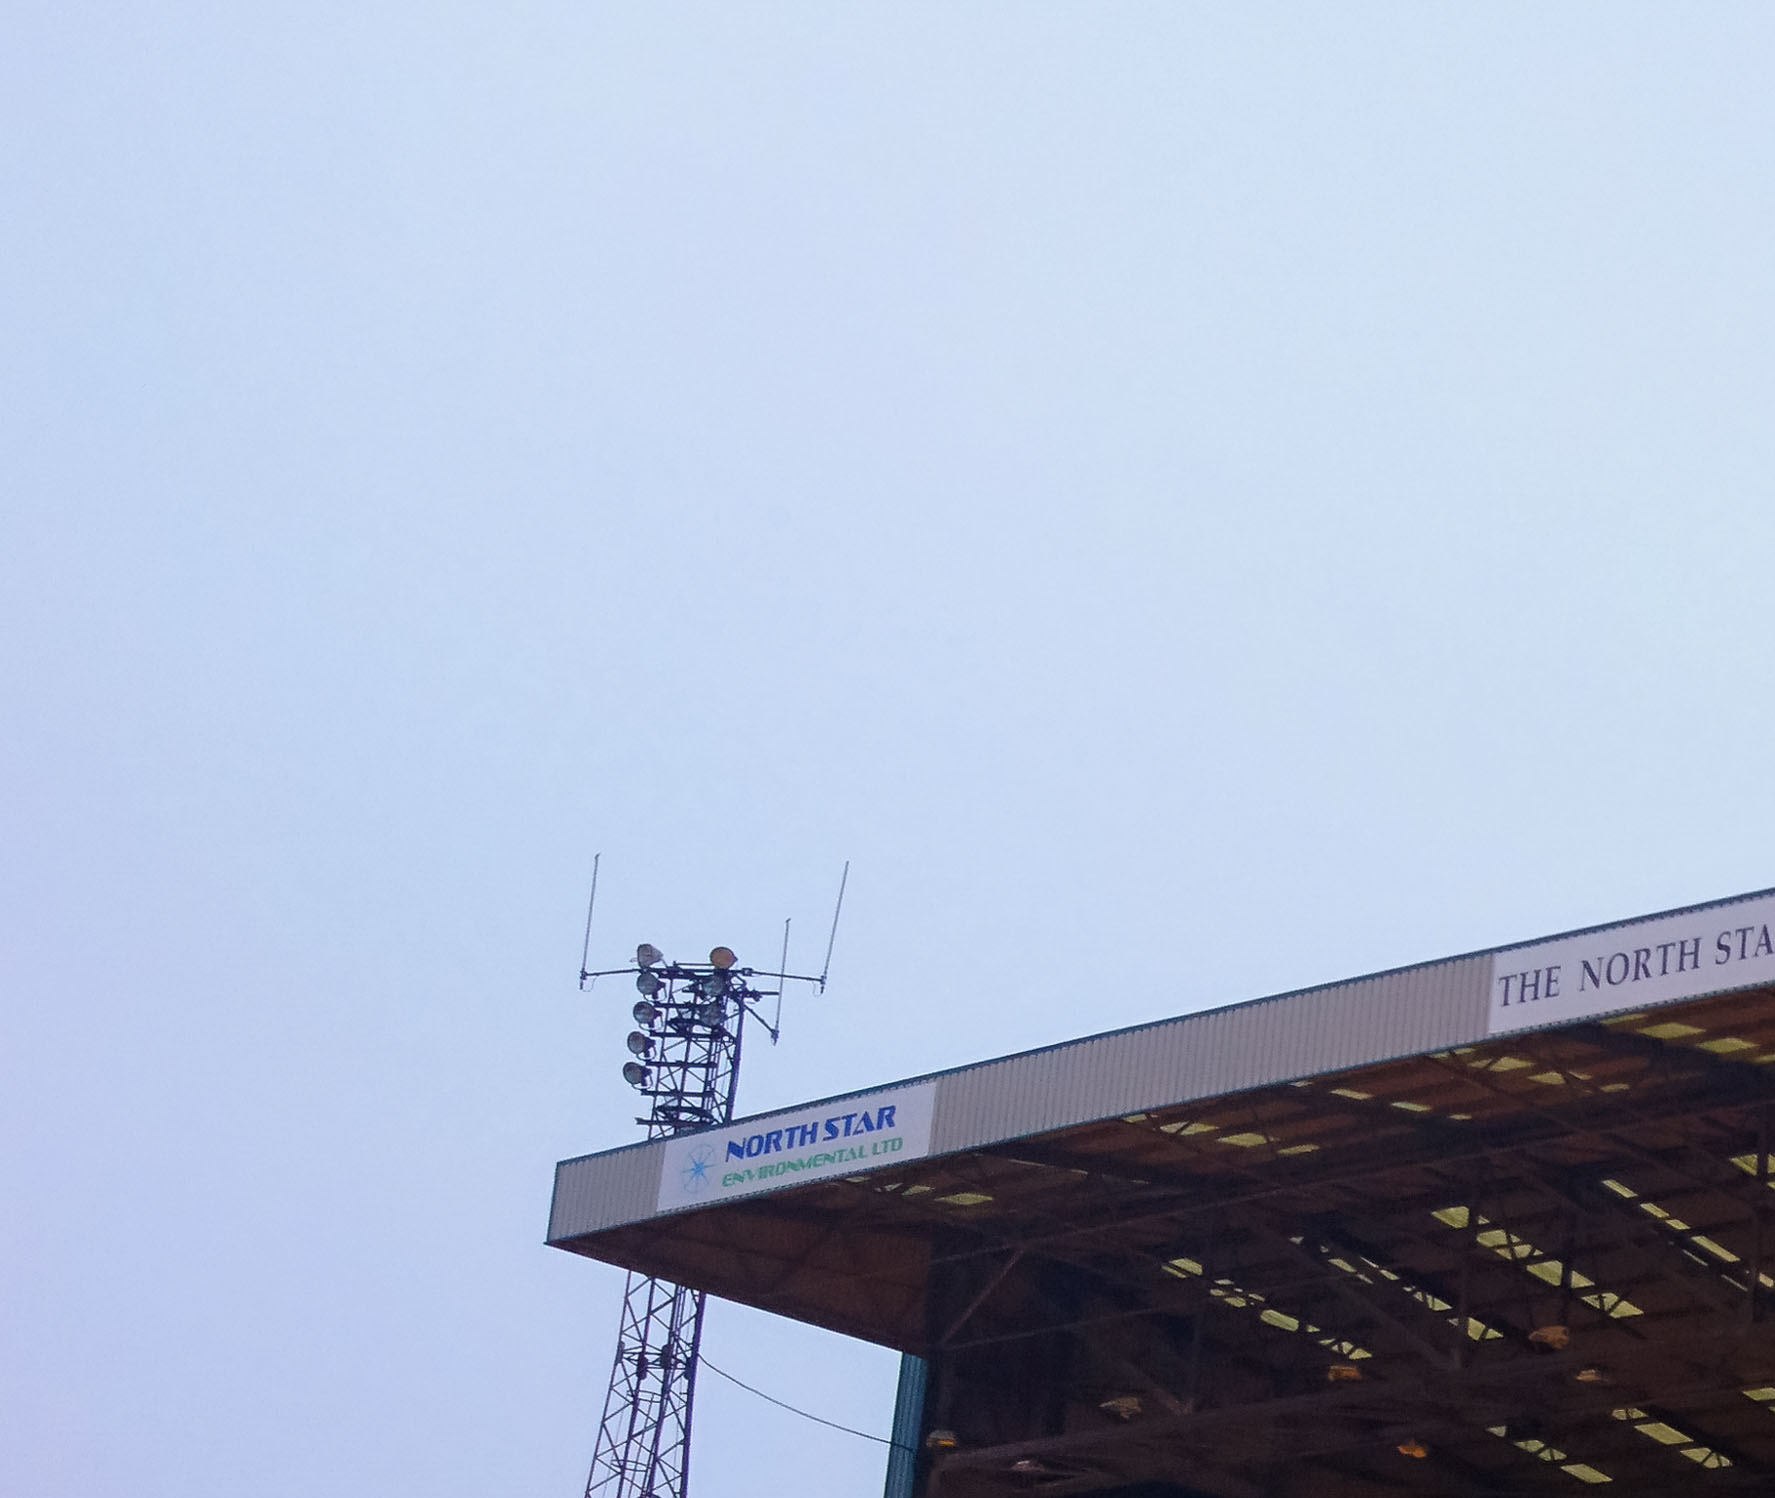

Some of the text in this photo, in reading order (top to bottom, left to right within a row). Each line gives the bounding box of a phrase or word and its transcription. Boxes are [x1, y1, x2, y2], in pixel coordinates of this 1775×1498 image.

[1499, 966, 1561, 1006] THE
[1580, 937, 1700, 991] NORTH
[721, 1137, 903, 1187] ENVIRONMENTAL LTD
[726, 1105, 896, 1162] NORTH STAR
